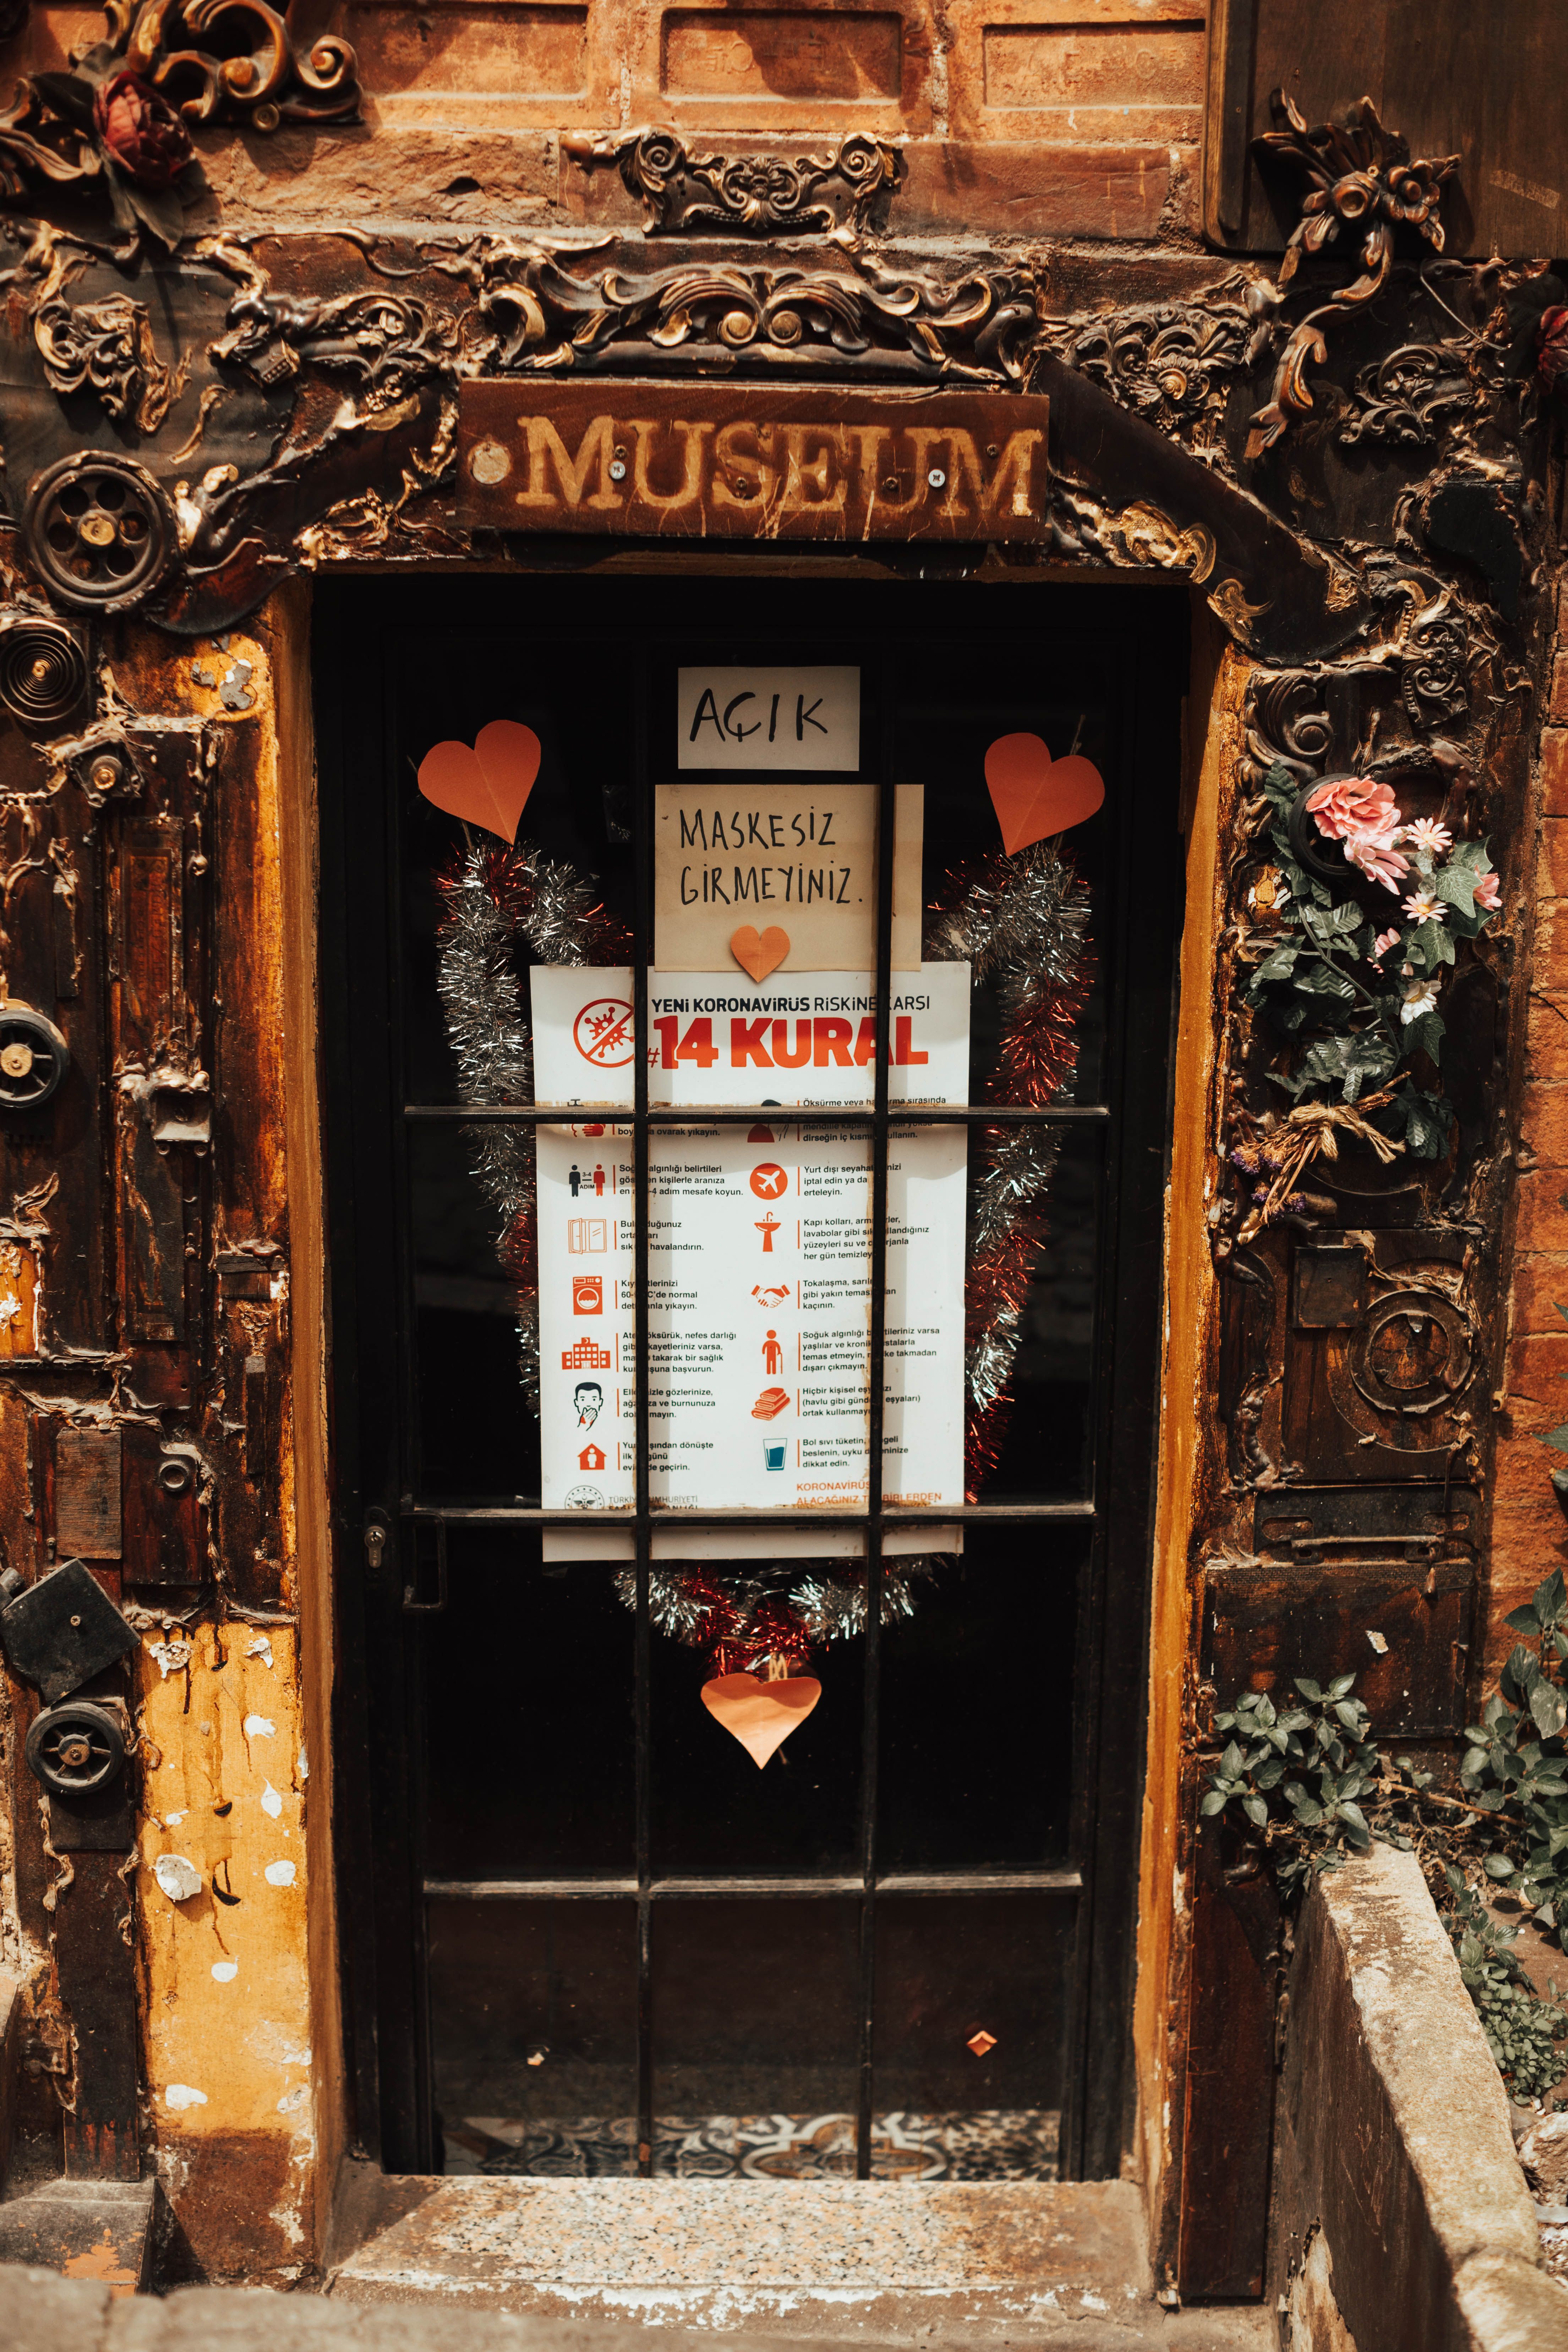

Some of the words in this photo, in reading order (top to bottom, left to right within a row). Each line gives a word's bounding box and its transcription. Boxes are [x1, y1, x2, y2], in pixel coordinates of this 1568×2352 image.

[516, 416, 1043, 516] MUSEUM
[689, 688, 828, 742] AÇIK
[679, 806, 836, 850] MASKESİZ
[681, 860, 863, 905] GİRMEYİNİZ.
[888, 995, 930, 1010] ARŞI
[731, 1016, 929, 1068] KURAL
[803, 1098, 841, 1107] Öksürme
[618, 1128, 654, 1136] boya
[688, 1129, 720, 1137] yıkayın.
[803, 1134, 837, 1143] dirseğin
[840, 1133, 847, 1142] iç
[619, 1164, 637, 1173] Soğ
[649, 1164, 682, 1173] algınlığı
[824, 1165, 838, 1174] dışı
[619, 1177, 657, 1185] gösen
[659, 1177, 692, 1185] kişilerle
[804, 1177, 822, 1186] iptal
[845, 1178, 854, 1186] ya
[715, 1189, 743, 1197] koyun.
[804, 1188, 842, 1197] erteleyin.
[621, 1221, 682, 1229] Bulduğunuz
[804, 1218, 823, 1227] Kapı
[825, 1218, 853, 1226] kolları,
[845, 1229, 860, 1237] gibi
[804, 1240, 841, 1250] yüzeyleri
[820, 1252, 835, 1261] gün
[621, 1280, 678, 1288] Kıytlerinizi
[803, 1279, 849, 1287] Tokalaşma,
[803, 1291, 818, 1299] gibi
[821, 1290, 843, 1298] yakın
[665, 1303, 697, 1311] yıkayın.
[803, 1302, 835, 1311] kaçının.
[710, 1332, 736, 1340] darlığı
[803, 1331, 829, 1340] Soğuk
[831, 1329, 864, 1339] algınlığı
[803, 1342, 832, 1351] yaşlılar
[699, 1354, 723, 1363] sağlık
[830, 1352, 865, 1360] etmeyin,
[672, 1365, 714, 1374] başvurun.
[803, 1364, 825, 1373] dışarı
[666, 1389, 713, 1397] gözlerinize,
[803, 1387, 826, 1396] Hiçbir
[829, 1386, 856, 1395] kişisel
[803, 1398, 827, 1407] (havlu
[830, 1397, 845, 1406] gibi
[885, 1395, 920, 1404] eşyaları)
[680, 1442, 714, 1450] dönüşte
[803, 1449, 840, 1457] beslenin,
